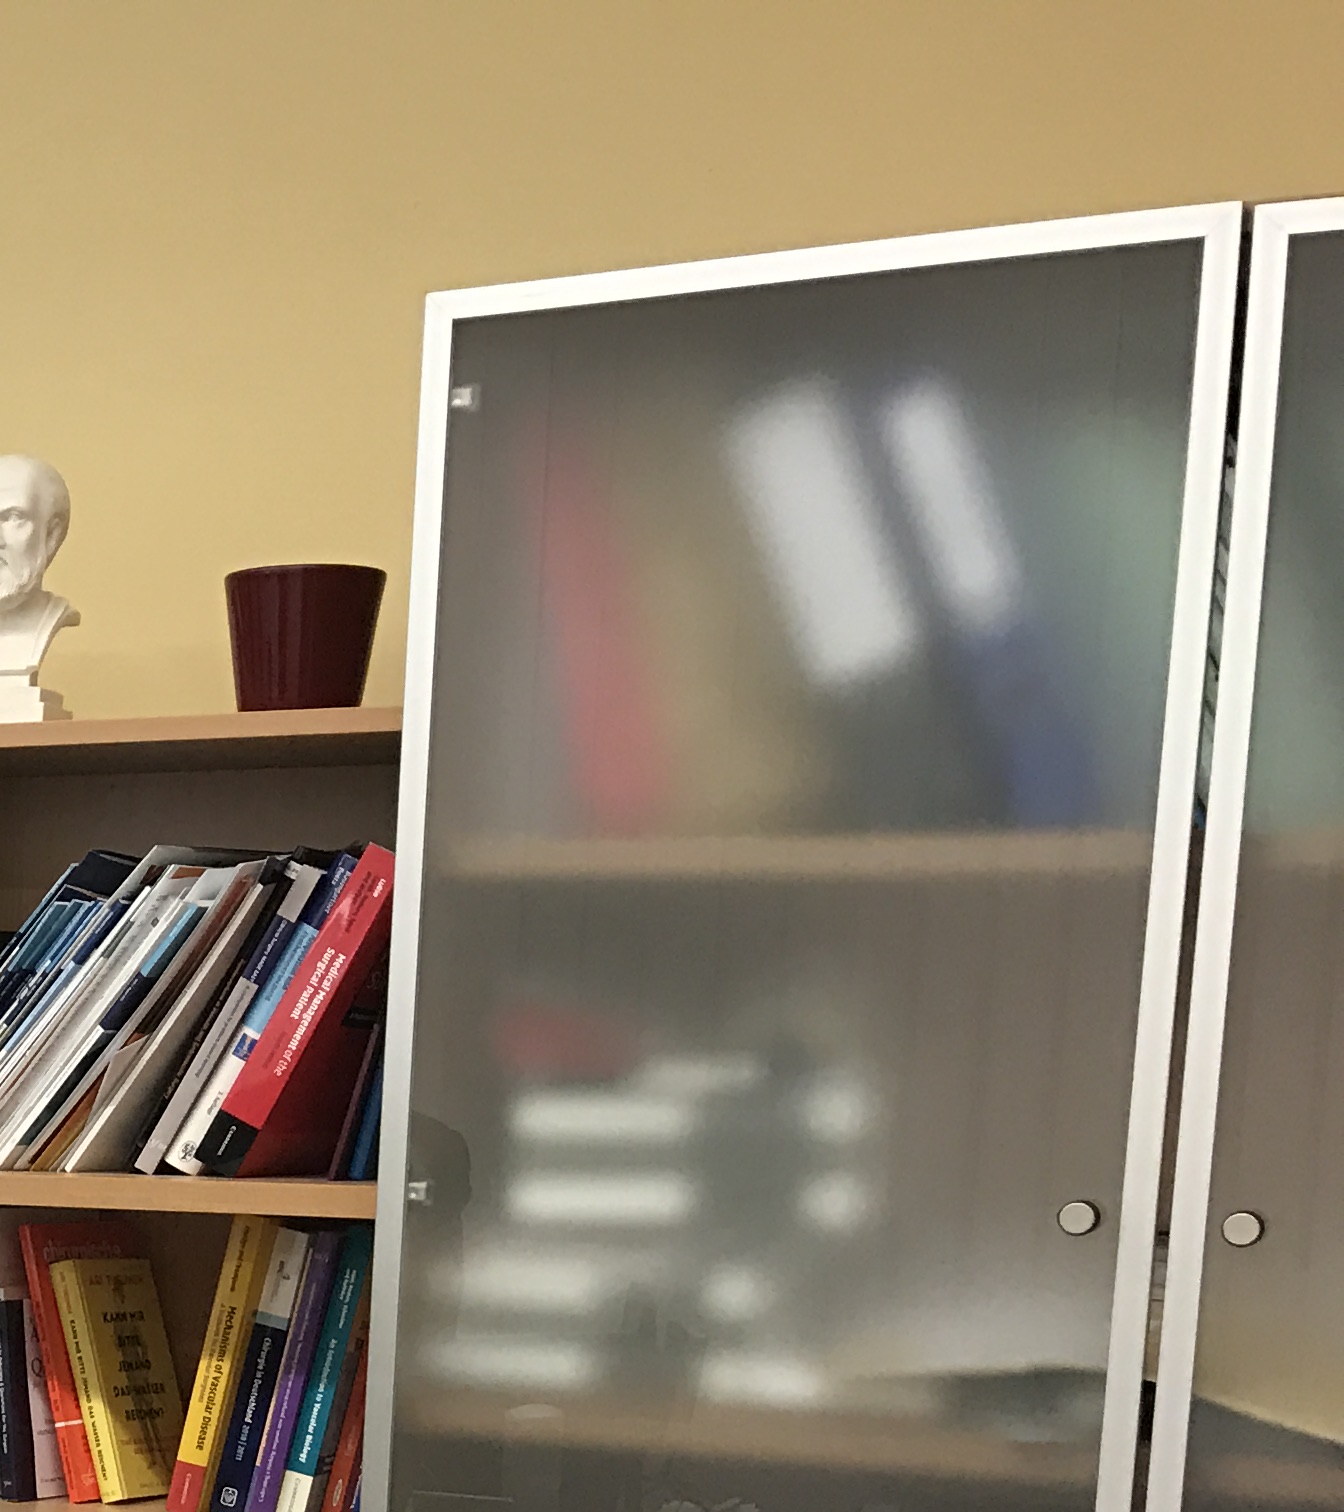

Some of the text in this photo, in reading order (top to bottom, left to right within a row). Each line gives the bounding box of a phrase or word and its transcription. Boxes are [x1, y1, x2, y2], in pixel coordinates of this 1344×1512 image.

[290, 945, 335, 1021] Surgical Patient
[320, 951, 346, 991] Medical
[287, 988, 325, 1051] Management
[272, 1058, 289, 1077] the
[280, 1048, 294, 1062] of
[255, 1336, 271, 1370] Chirurgie
[195, 1304, 236, 1451] Mechanisms of Vascular Disease
[254, 1370, 264, 1378] in
[244, 1378, 261, 1423] Deutschland
[315, 1393, 323, 1402] to
[308, 1402, 320, 1434] Vascular
[299, 1433, 312, 1463] Biology
